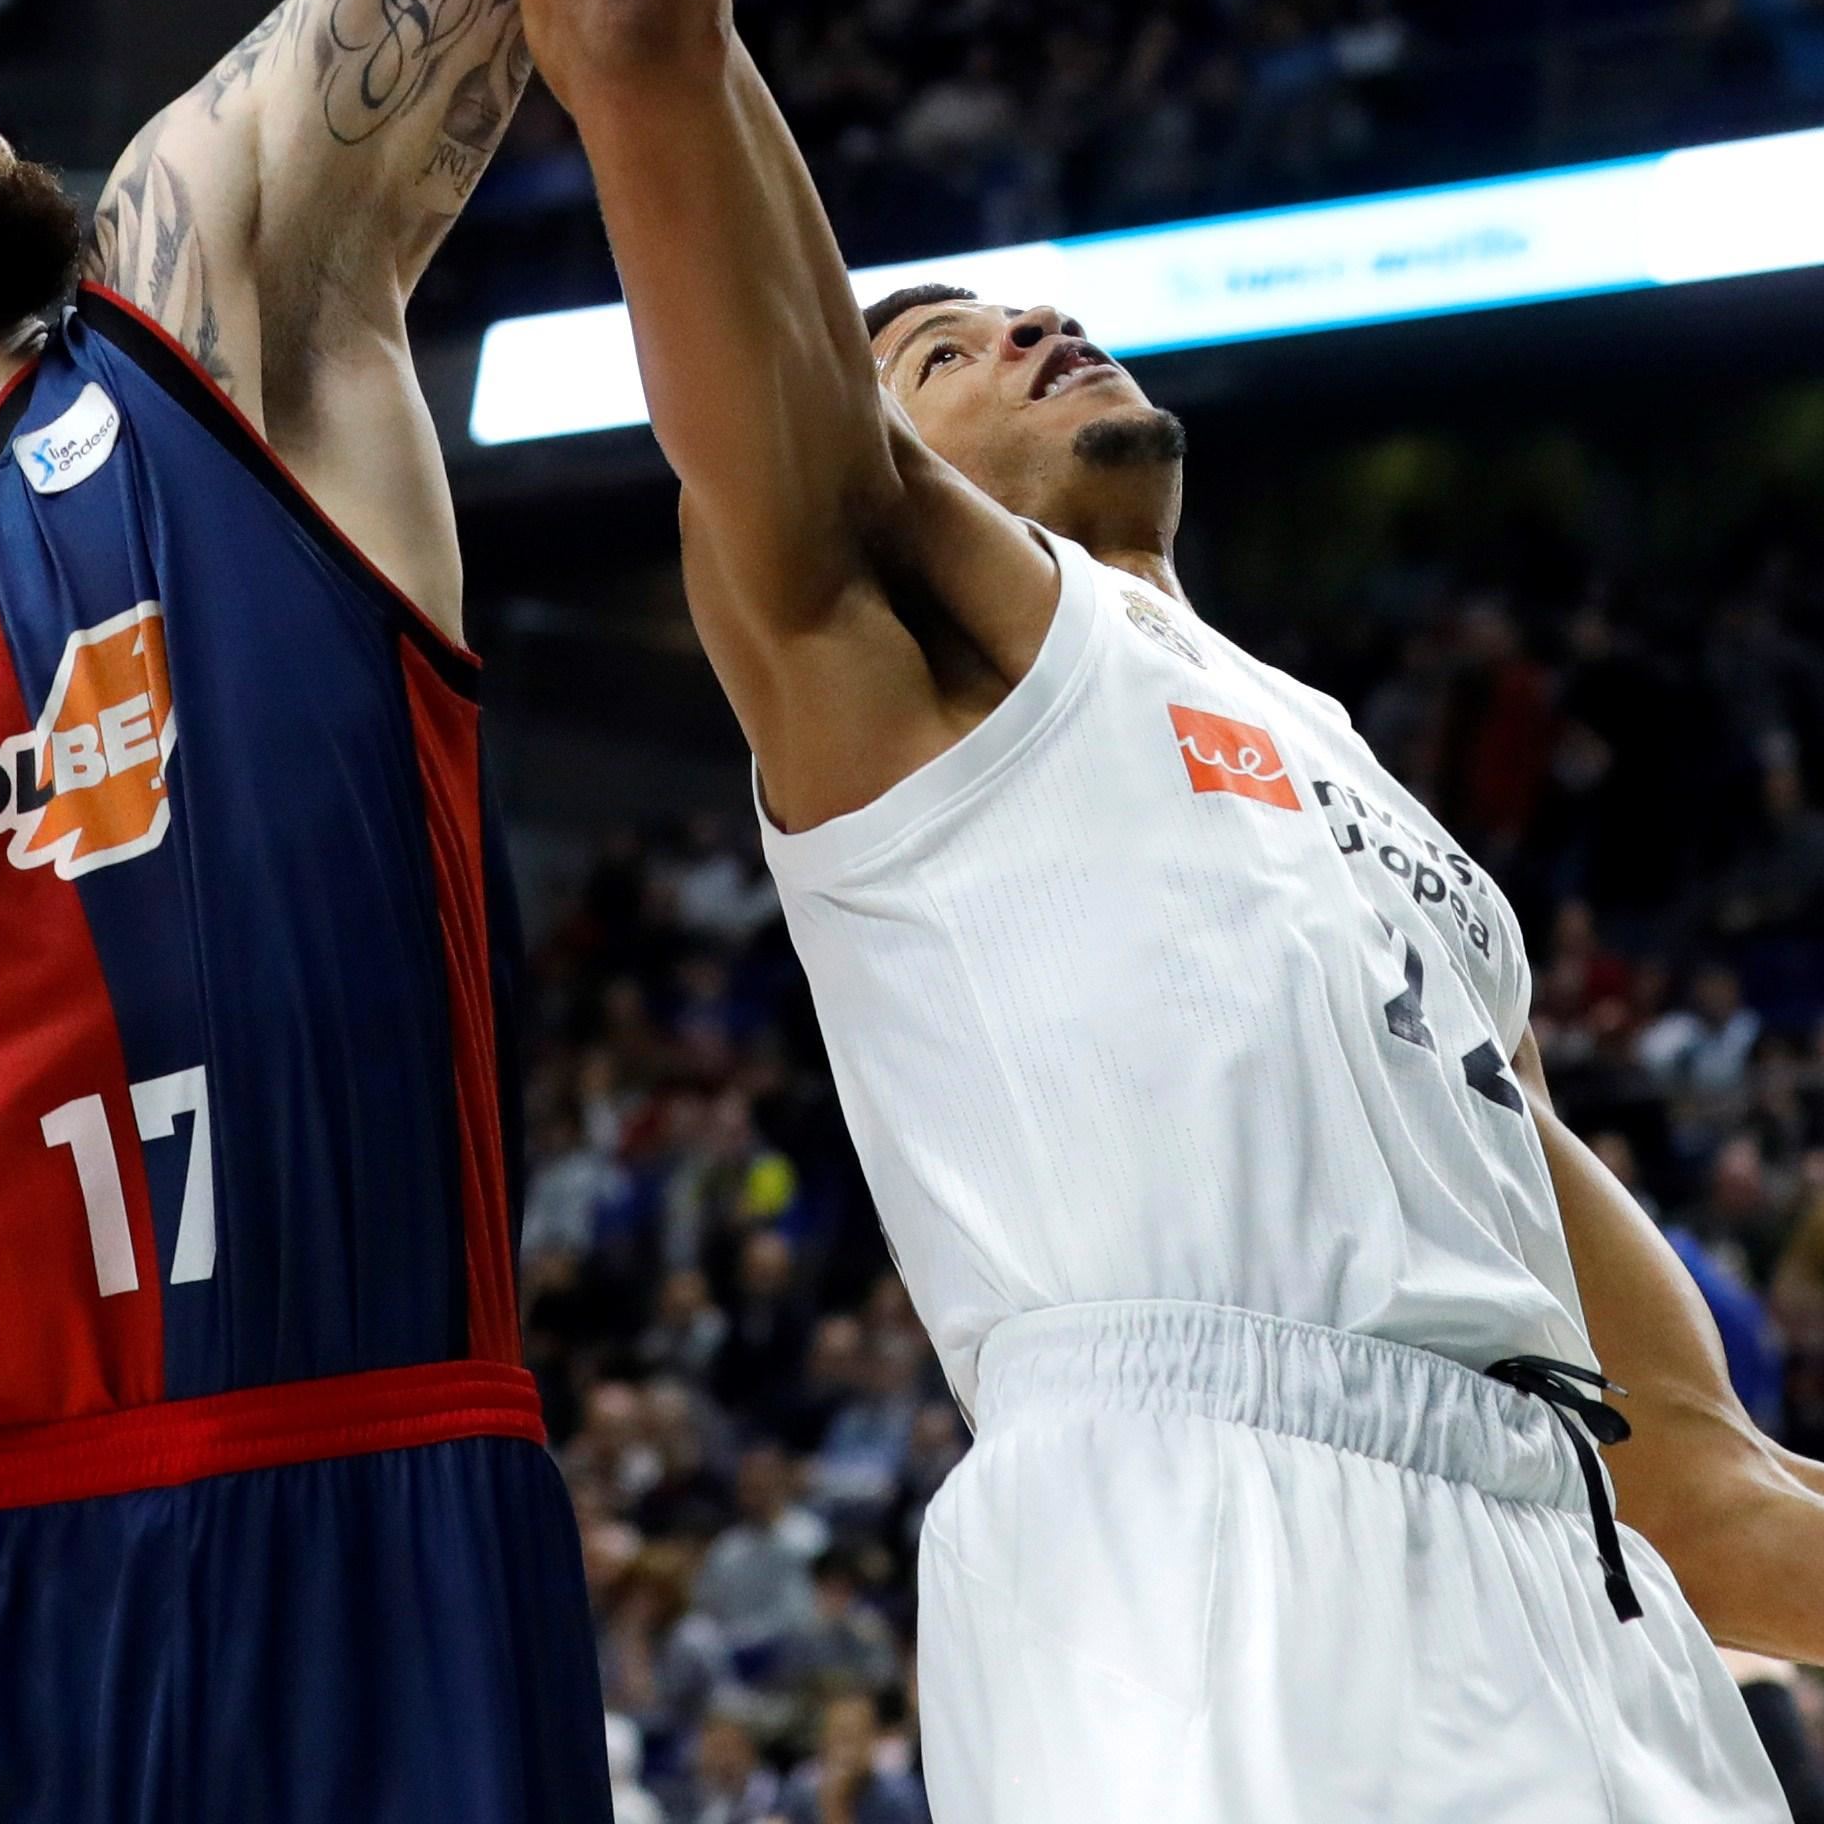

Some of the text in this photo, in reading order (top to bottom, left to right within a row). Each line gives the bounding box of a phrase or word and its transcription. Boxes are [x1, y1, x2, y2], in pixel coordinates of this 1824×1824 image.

[48, 440, 78, 461] liga
[58, 413, 116, 472] endesa
[1330, 822, 1491, 962] uopea
[39, 1063, 217, 1299] 17
